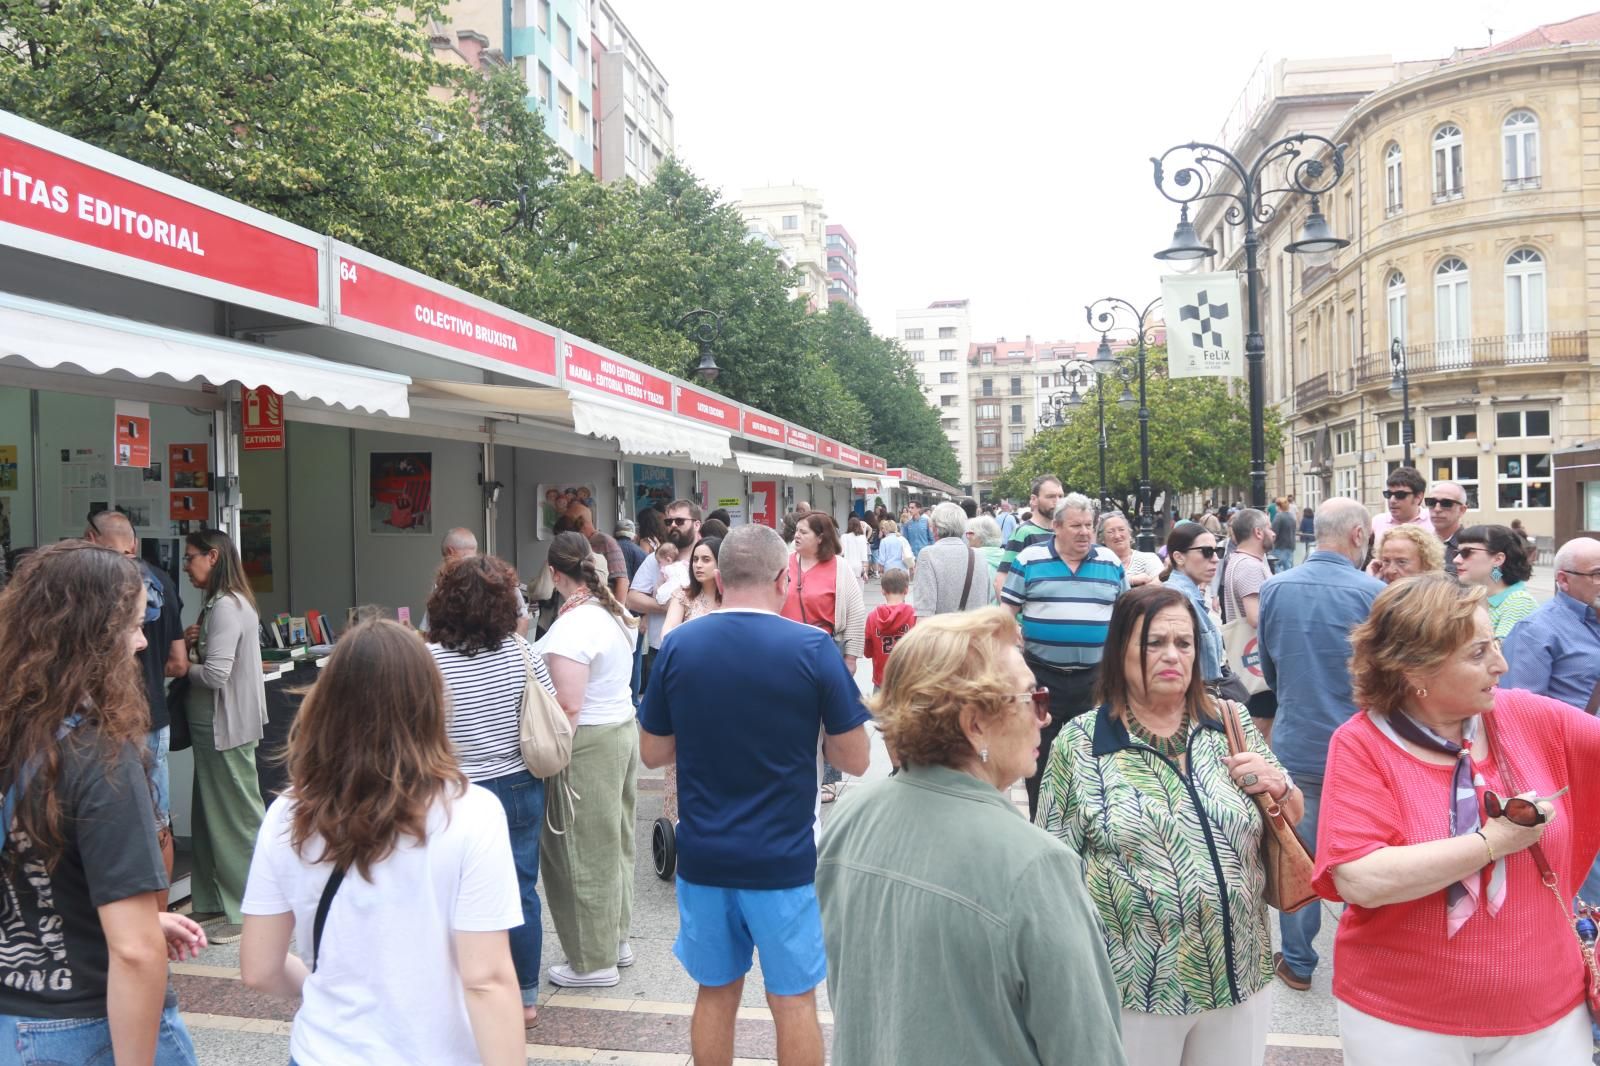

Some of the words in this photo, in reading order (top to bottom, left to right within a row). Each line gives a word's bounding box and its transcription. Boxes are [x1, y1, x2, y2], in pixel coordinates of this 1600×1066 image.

[0, 168, 69, 214] ITAS
[77, 193, 205, 256] EDITORIAL
[340, 262, 358, 283] 64
[415, 304, 473, 337] COLECTIVO
[475, 324, 518, 352] BRUXISTA
[596, 373, 624, 393] EDITORIAL
[245, 435, 281, 444] EXTINTOR
[0, 967, 73, 992] ONG
